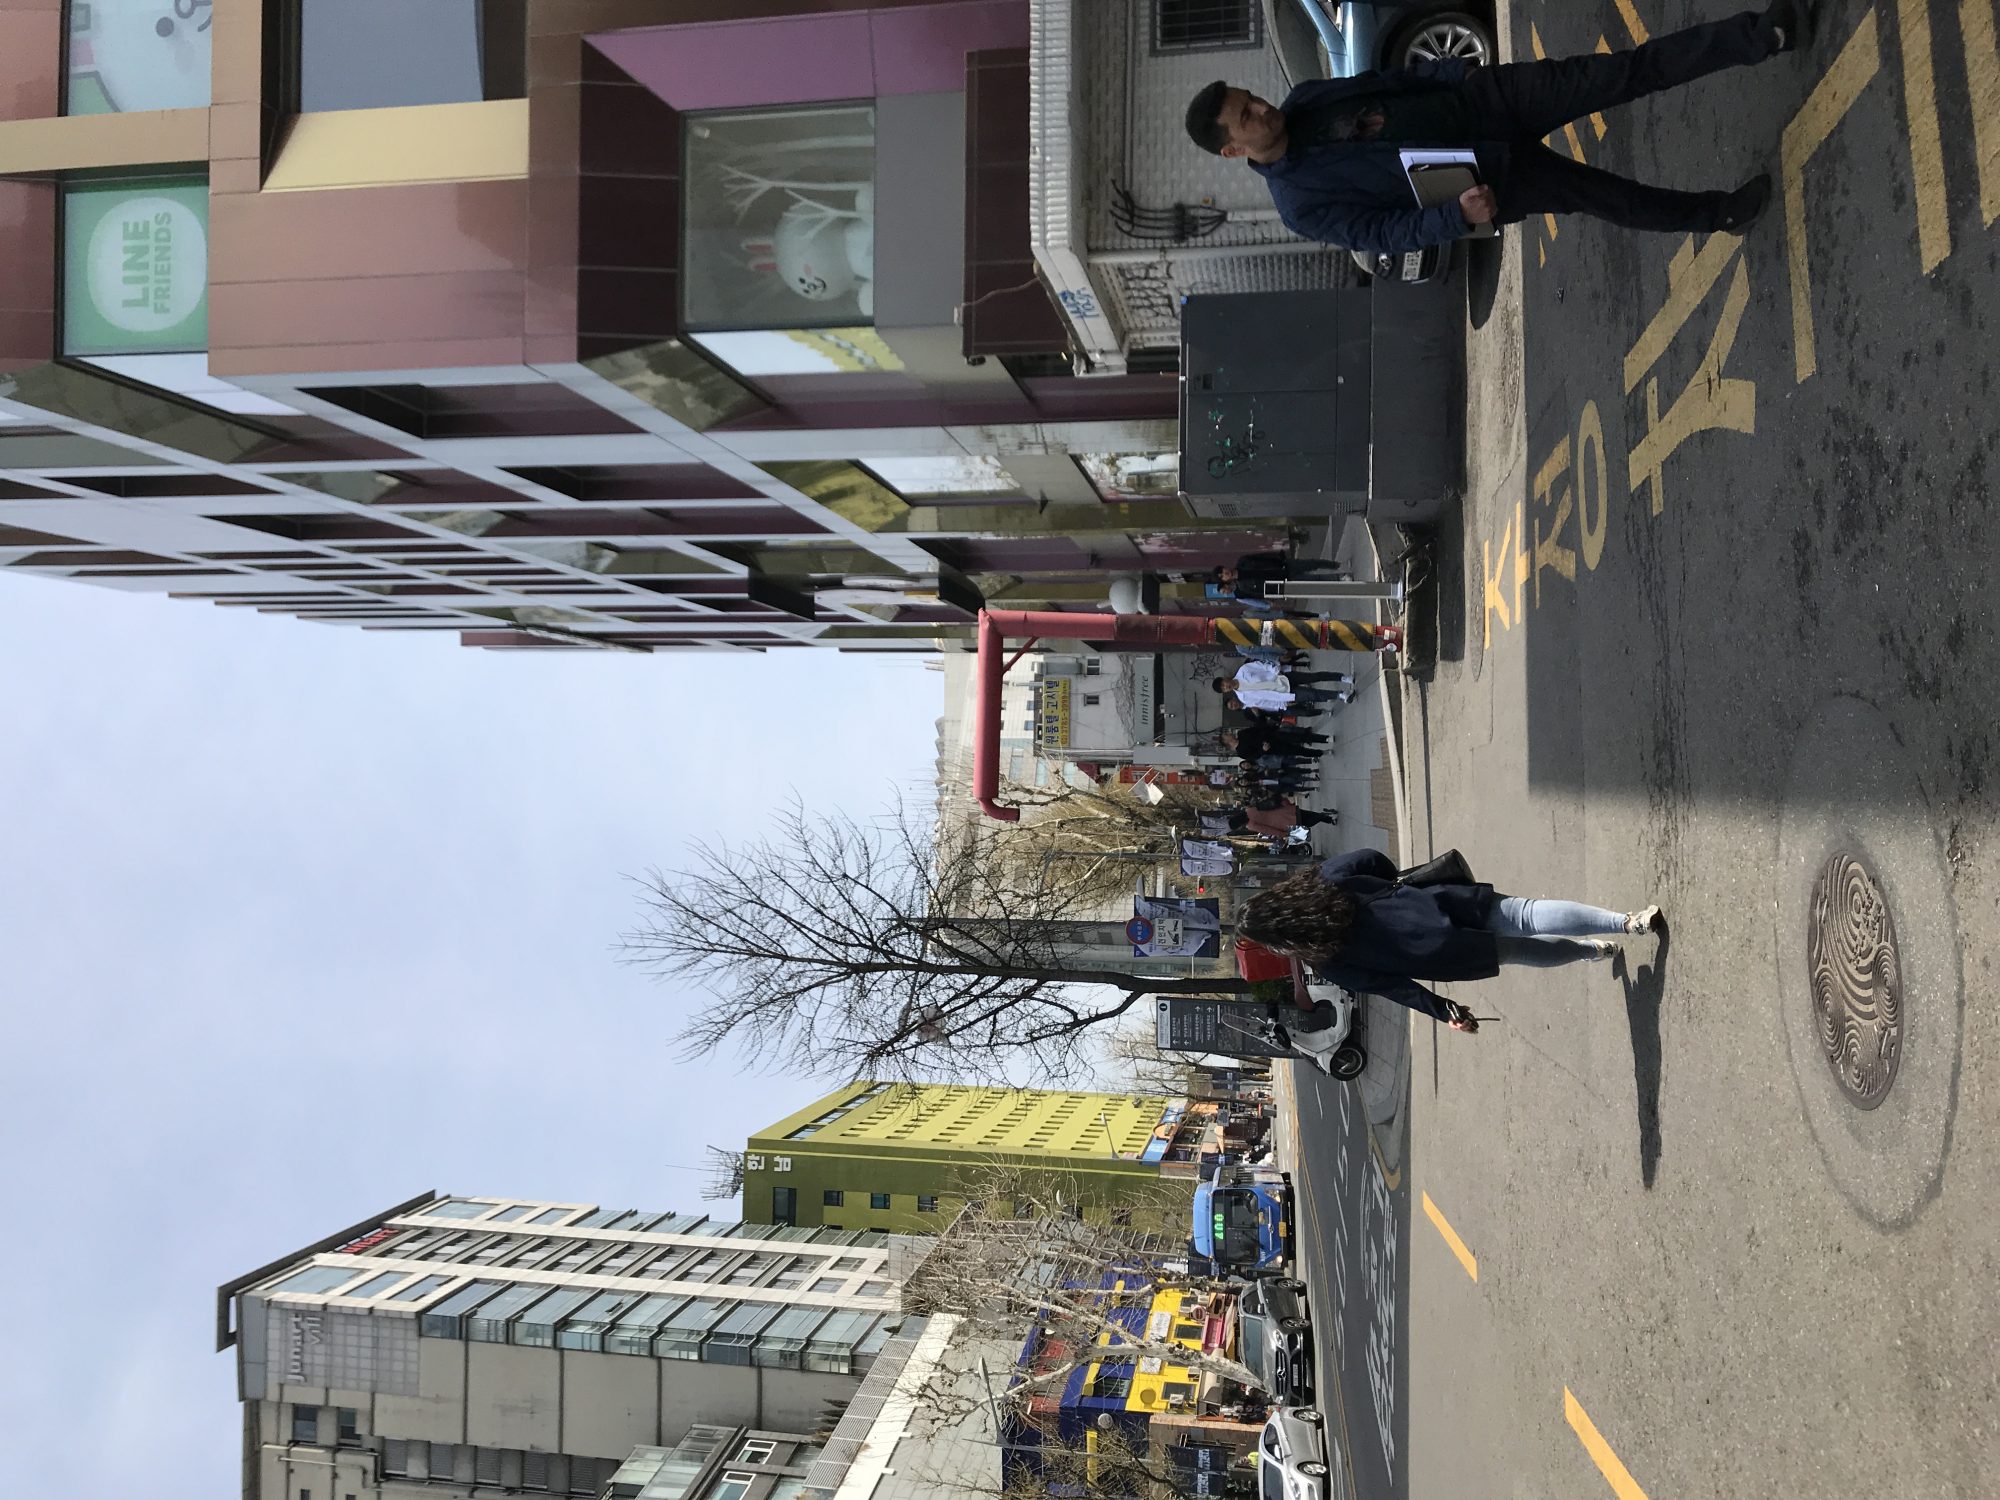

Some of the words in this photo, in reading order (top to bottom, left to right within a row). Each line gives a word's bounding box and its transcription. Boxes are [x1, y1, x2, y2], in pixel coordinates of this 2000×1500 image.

[122, 220, 149, 309] LINE
[153, 212, 171, 315] FRIENDS
[1140, 675, 1149, 725] innisfree
[341, 1228, 400, 1254] unart
[1214, 1213, 1225, 1240] 400
[306, 1316, 321, 1344] vill
